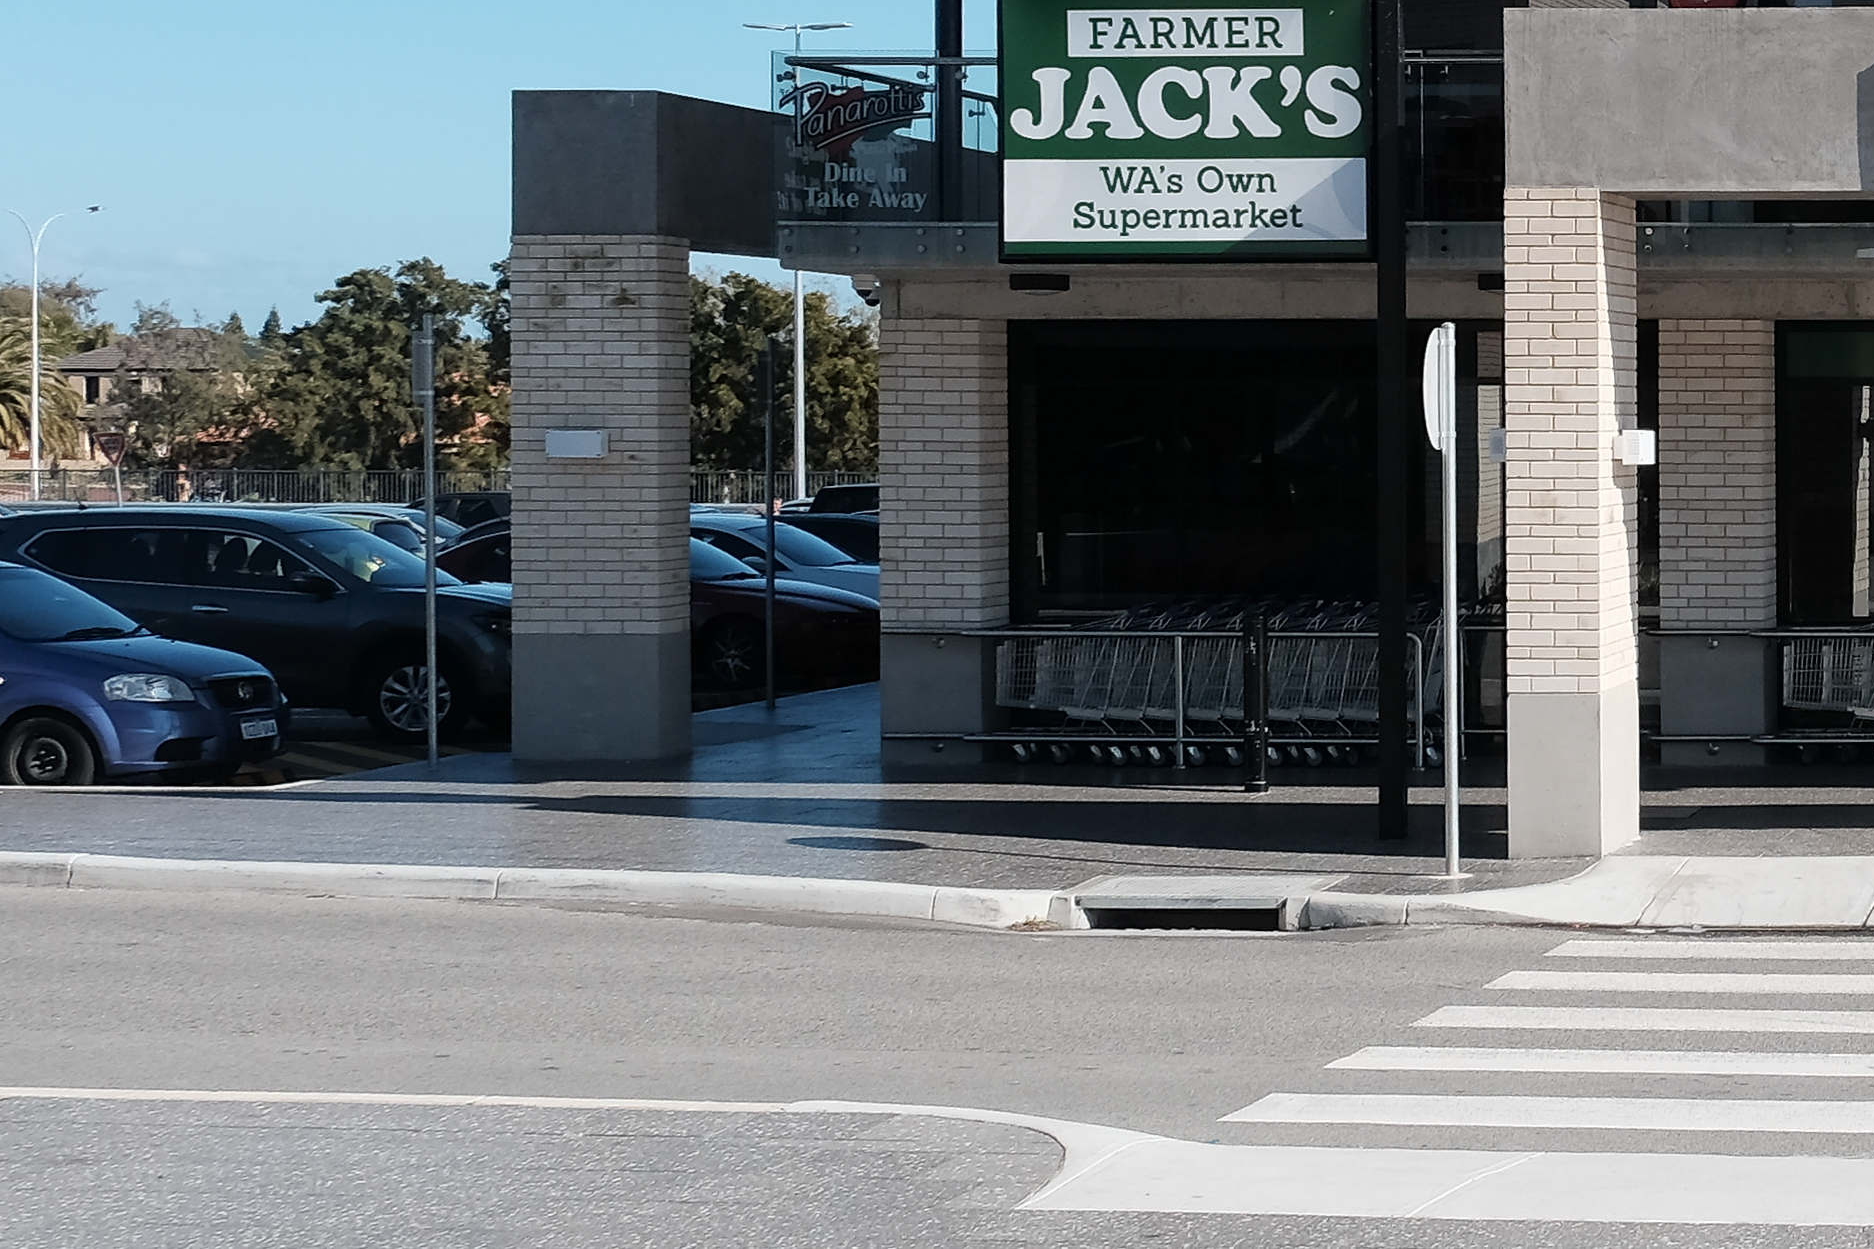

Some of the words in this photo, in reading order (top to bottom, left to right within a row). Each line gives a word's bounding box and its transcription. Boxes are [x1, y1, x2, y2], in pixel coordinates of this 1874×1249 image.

[1088, 16, 1283, 50] FARMER
[779, 82, 926, 147] Panarottis
[1009, 65, 1363, 140] JACK'S
[825, 162, 876, 183] Dine
[886, 163, 907, 183] In
[1099, 165, 1183, 194] WA's
[1197, 165, 1277, 194] Own
[804, 187, 860, 209] Take
[869, 189, 927, 212] Away
[1073, 201, 1304, 236] Supermarket
